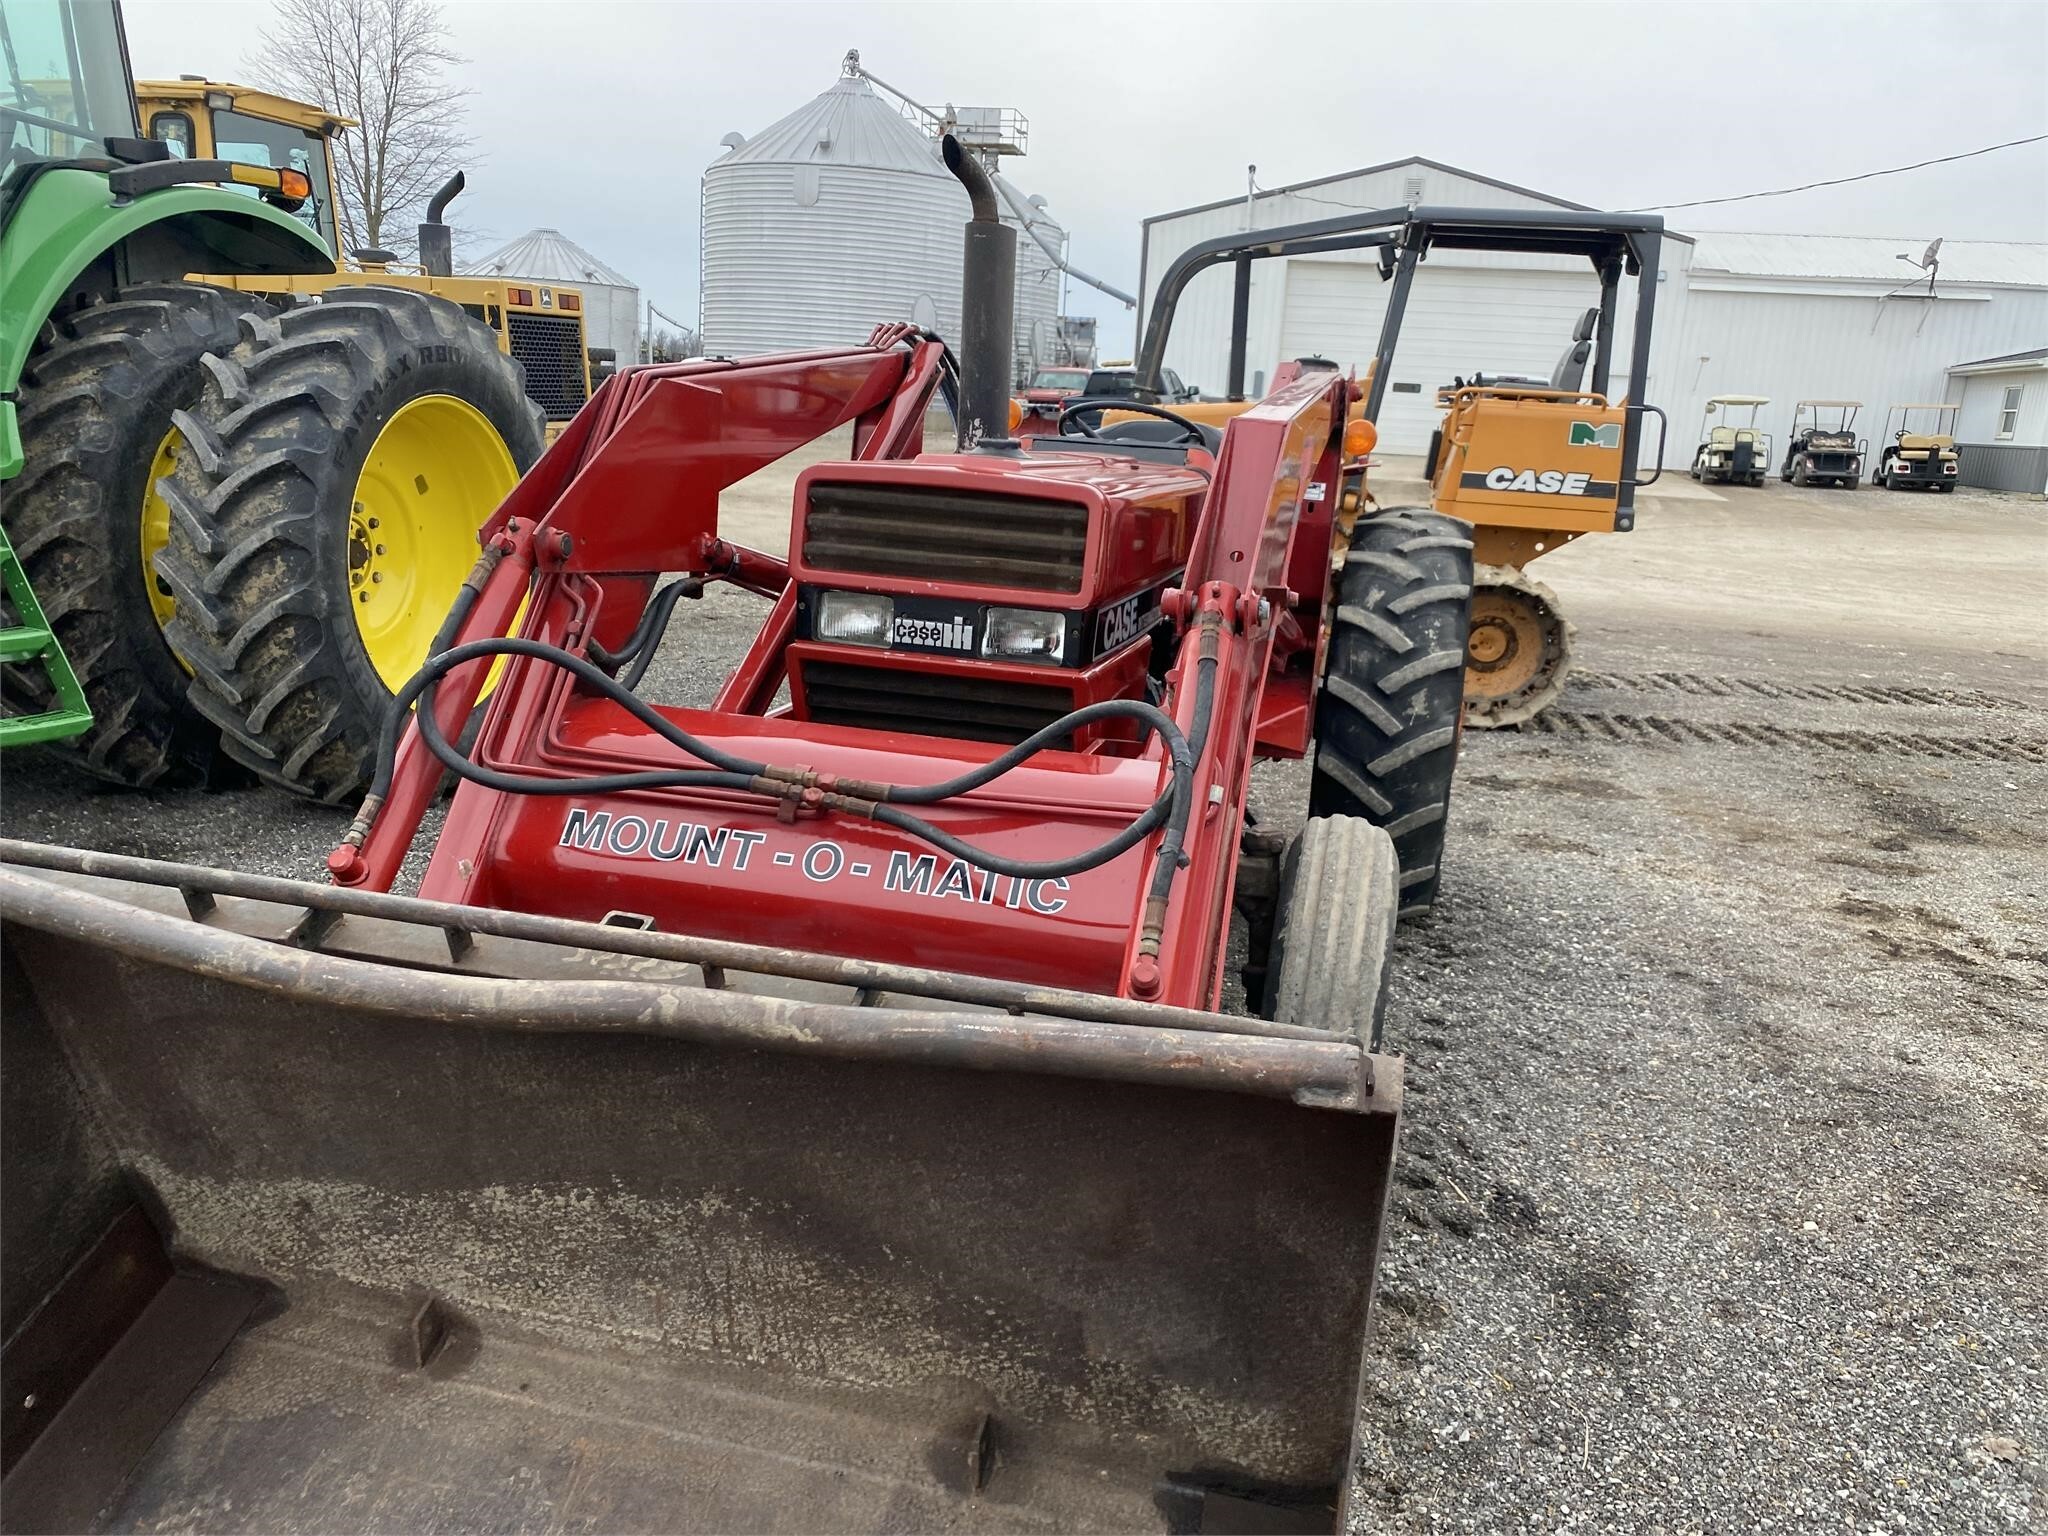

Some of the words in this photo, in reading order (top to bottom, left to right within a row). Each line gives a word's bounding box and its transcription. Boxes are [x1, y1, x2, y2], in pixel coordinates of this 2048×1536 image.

[1568, 421, 1622, 448] M
[1485, 466, 1592, 495] CASE
[1104, 597, 1138, 650] CASE
[559, 808, 767, 871] MOUNT
[884, 850, 1070, 914] MATIC
